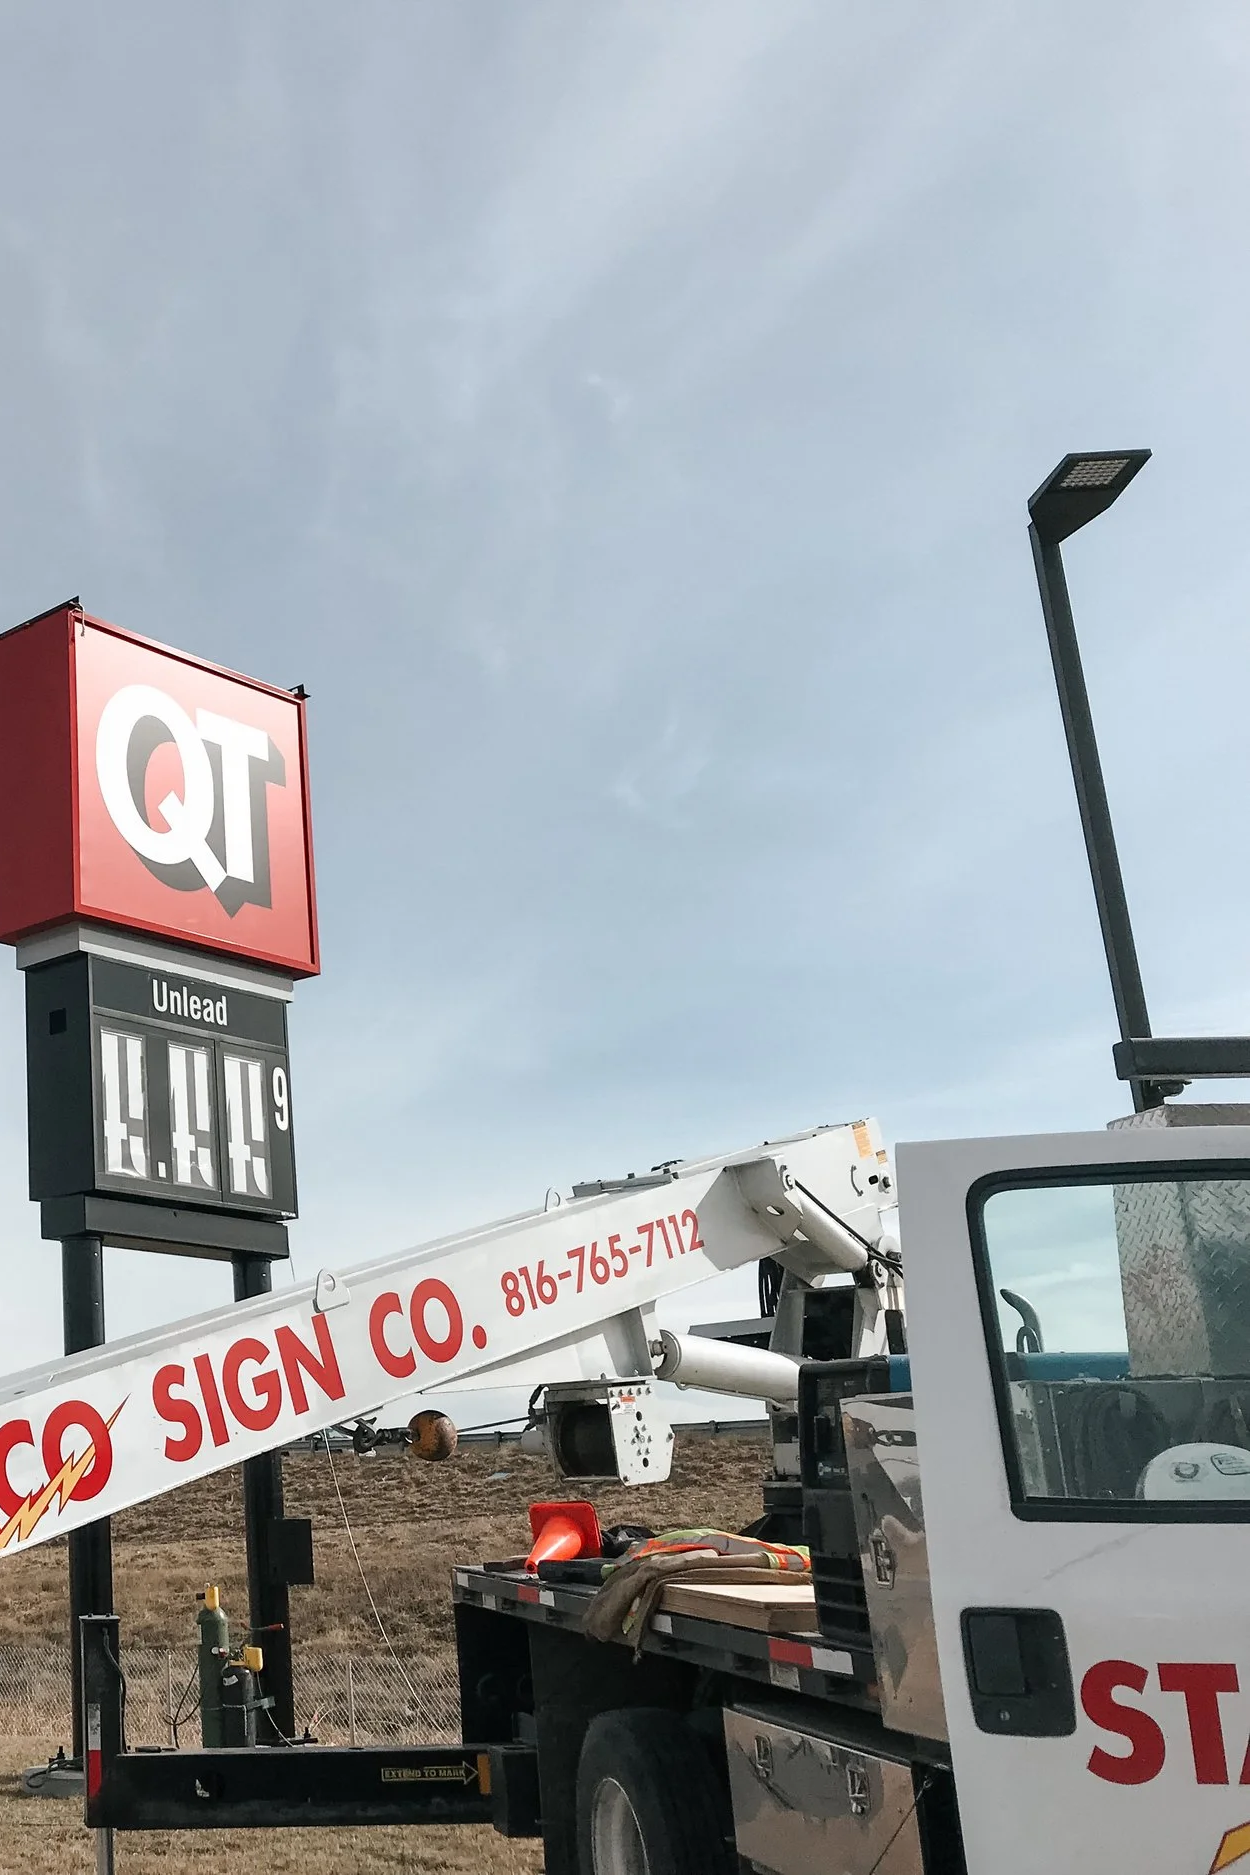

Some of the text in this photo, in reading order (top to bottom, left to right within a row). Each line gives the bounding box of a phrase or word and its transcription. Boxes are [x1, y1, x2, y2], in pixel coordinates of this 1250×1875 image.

[96, 684, 269, 894] QT
[152, 978, 228, 1026] Unlead
[272, 1066, 290, 1132] 9
[501, 1208, 705, 1318] 816-765-7112
[151, 1313, 346, 1462] SIGN
[368, 1278, 488, 1378] CO.
[423, 1768, 437, 1778] TO
[438, 1768, 466, 1778] MARK
[1080, 1659, 1250, 1786] ST
